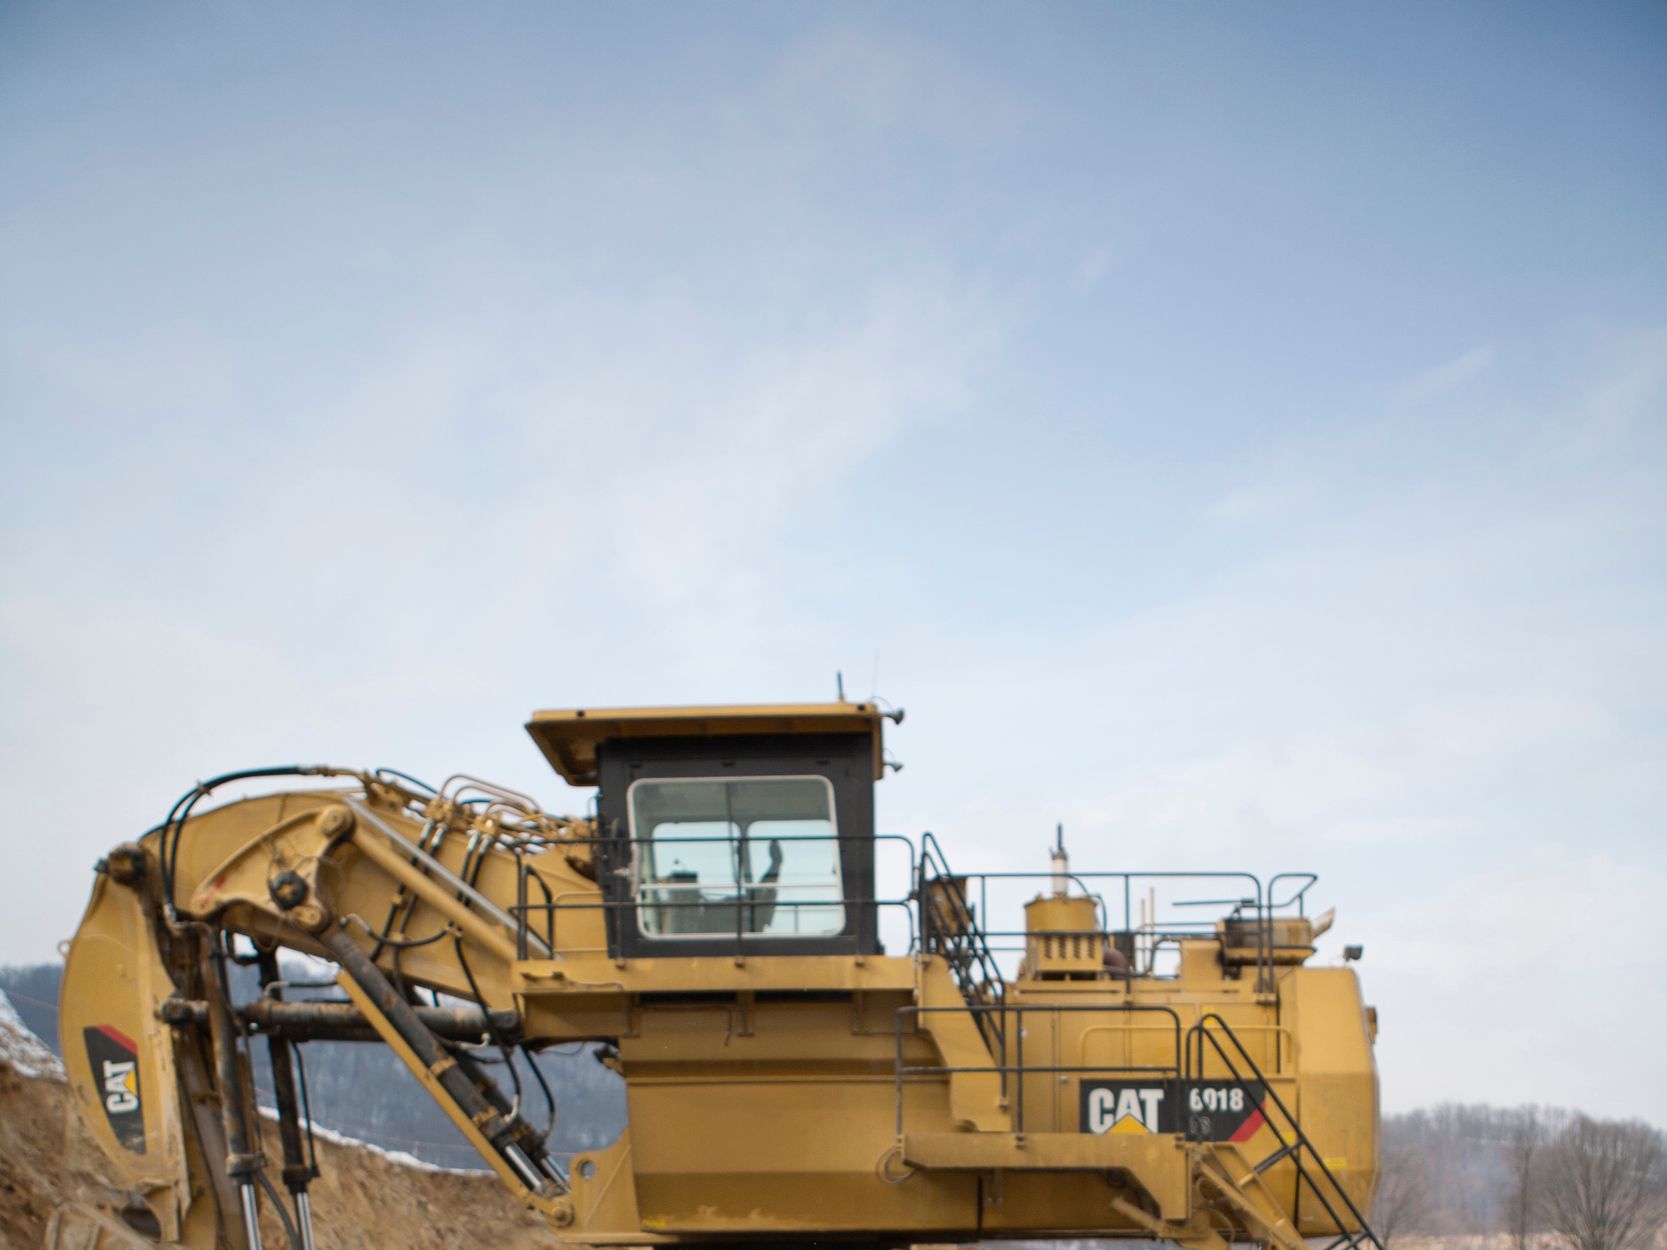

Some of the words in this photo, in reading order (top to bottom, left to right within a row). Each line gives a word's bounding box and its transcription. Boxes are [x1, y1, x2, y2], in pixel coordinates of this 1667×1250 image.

[103, 1060, 139, 1114] CAT
[1088, 1087, 1165, 1135] CAT
[1189, 1088, 1244, 1112] 6018
